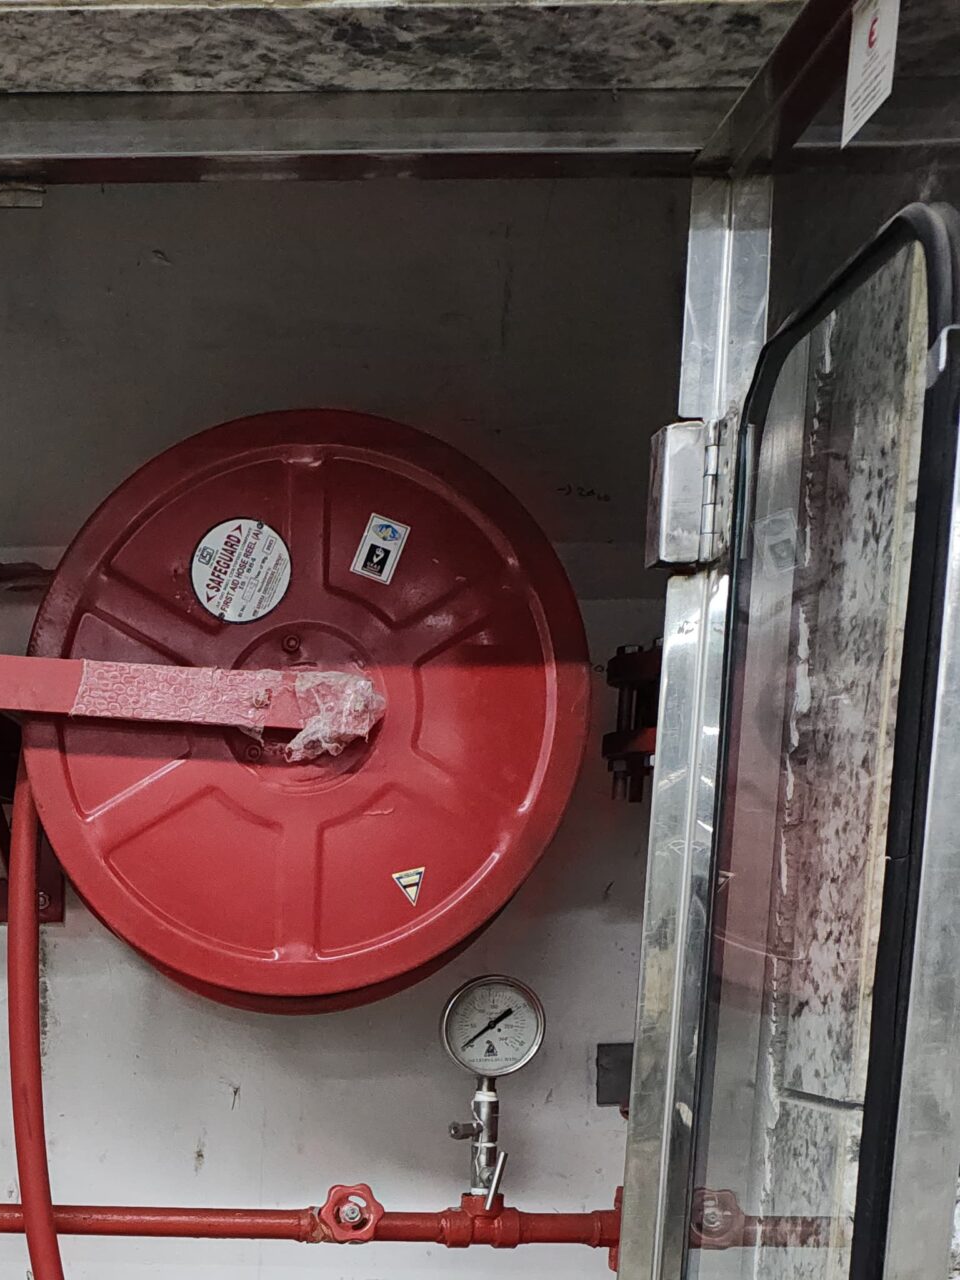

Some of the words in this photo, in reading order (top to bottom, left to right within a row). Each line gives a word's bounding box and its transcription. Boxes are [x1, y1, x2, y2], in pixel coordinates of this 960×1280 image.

[206, 534, 241, 592] SAFEGUARD
[221, 591, 232, 612] FIRST
[231, 579, 240, 592] AID
[237, 560, 249, 579] HOSE
[243, 541, 257, 559] REEL
[251, 529, 263, 541] (A)
